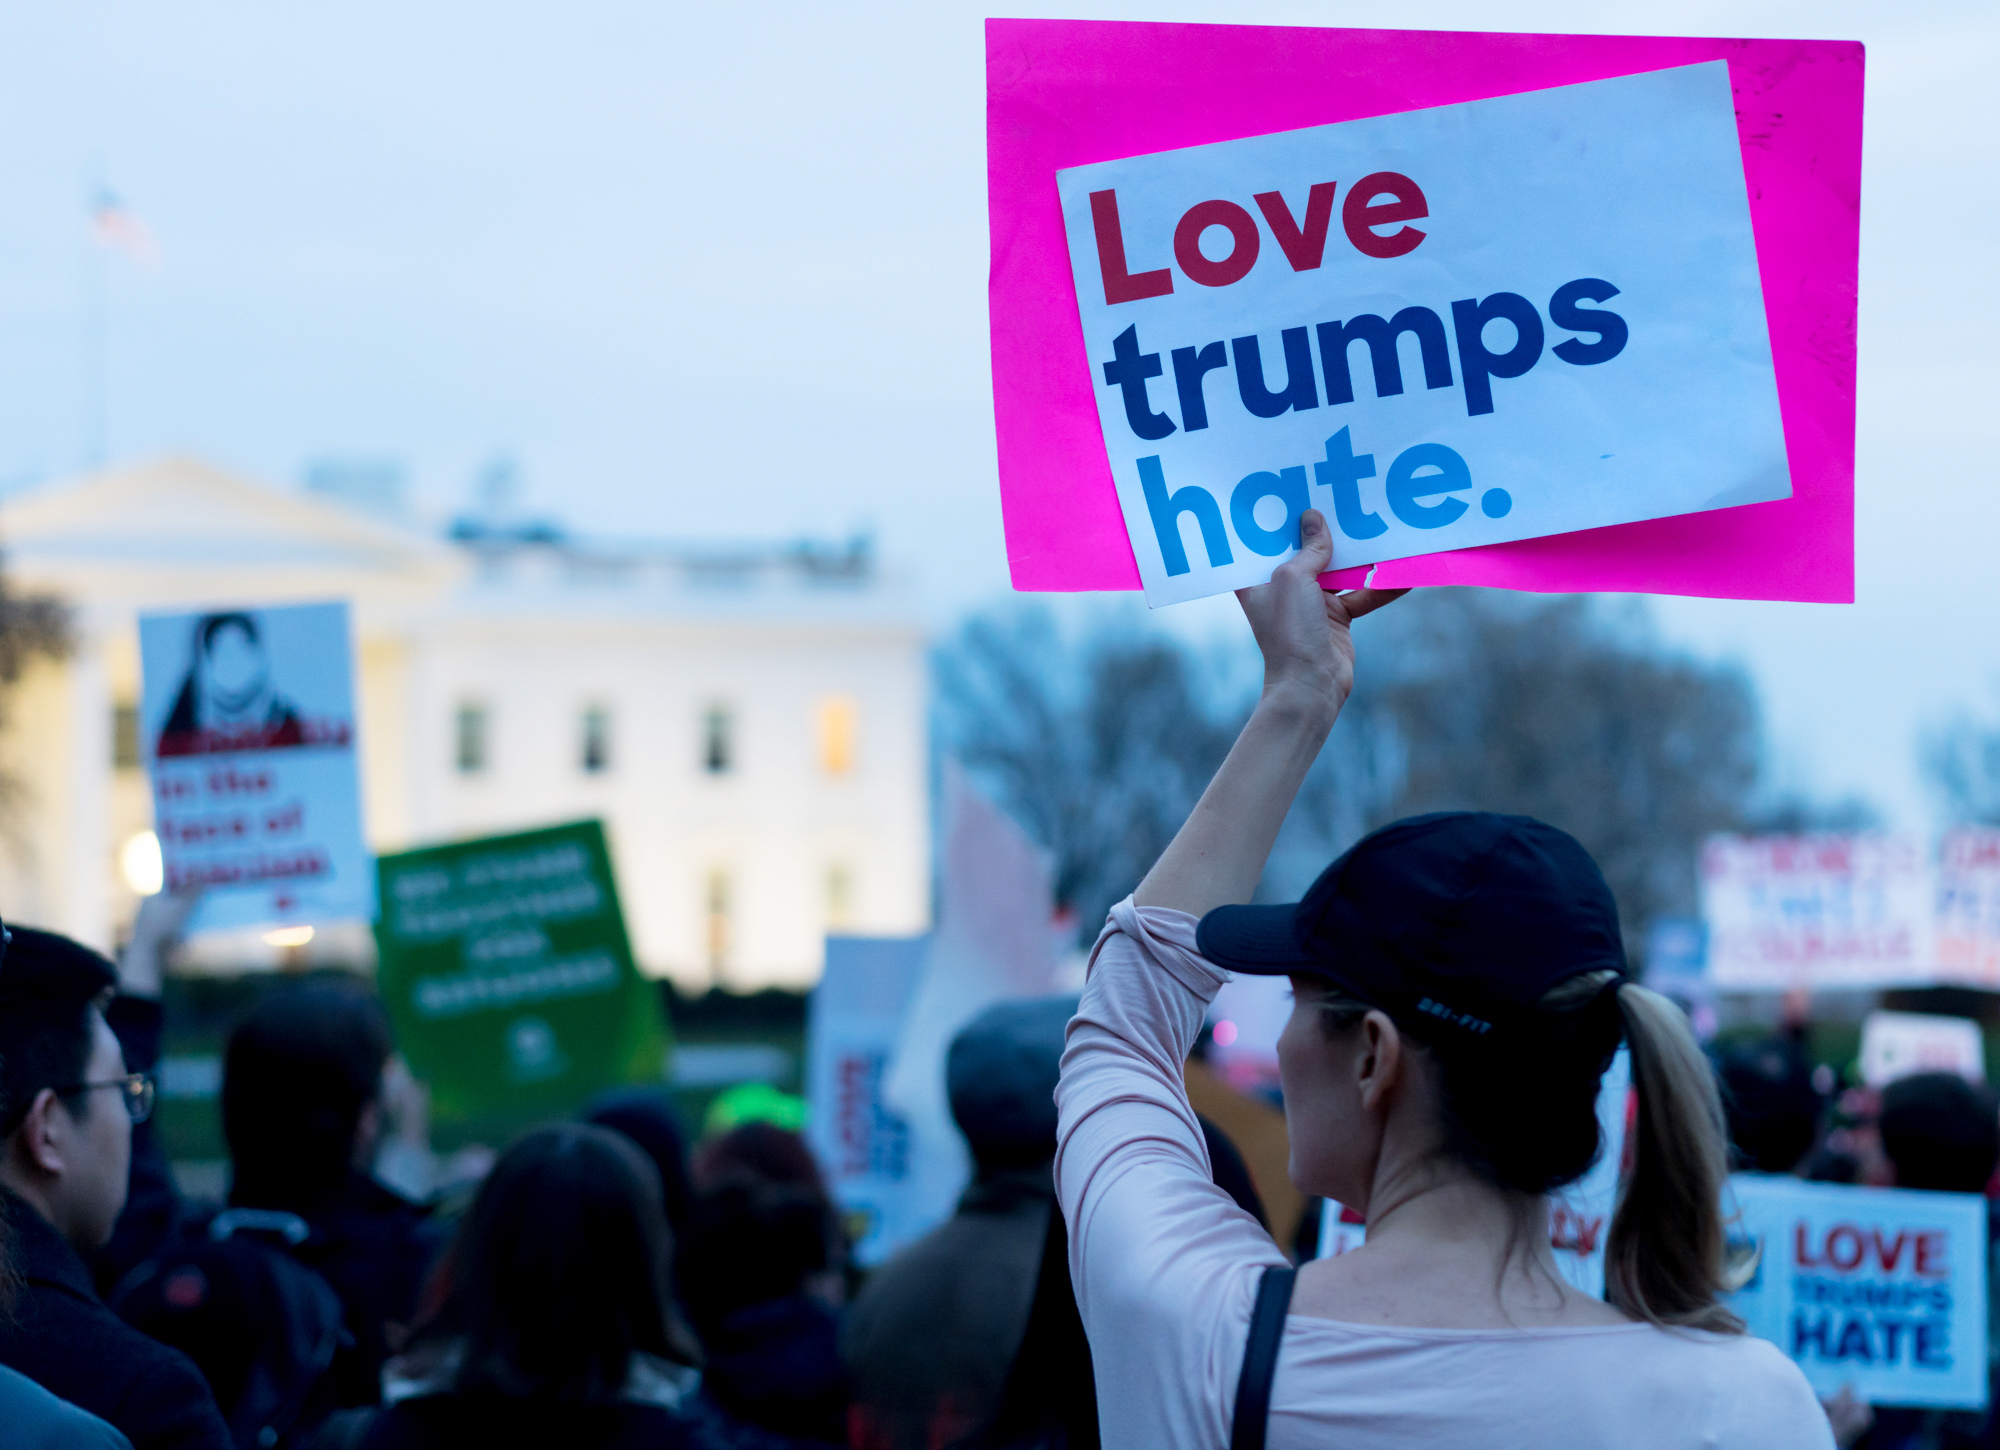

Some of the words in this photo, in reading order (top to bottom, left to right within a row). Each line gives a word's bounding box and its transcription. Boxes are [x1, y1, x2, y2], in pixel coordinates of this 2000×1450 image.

[1089, 171, 1429, 305] Love
[1102, 277, 1628, 441] trumps
[1136, 424, 1513, 577] hate.
[1416, 997, 1493, 1035] DRI-FIT
[1793, 1219, 1950, 1276] LOVE
[1794, 1275, 1952, 1311] TRUMPS
[1793, 1311, 1952, 1367] HATE
